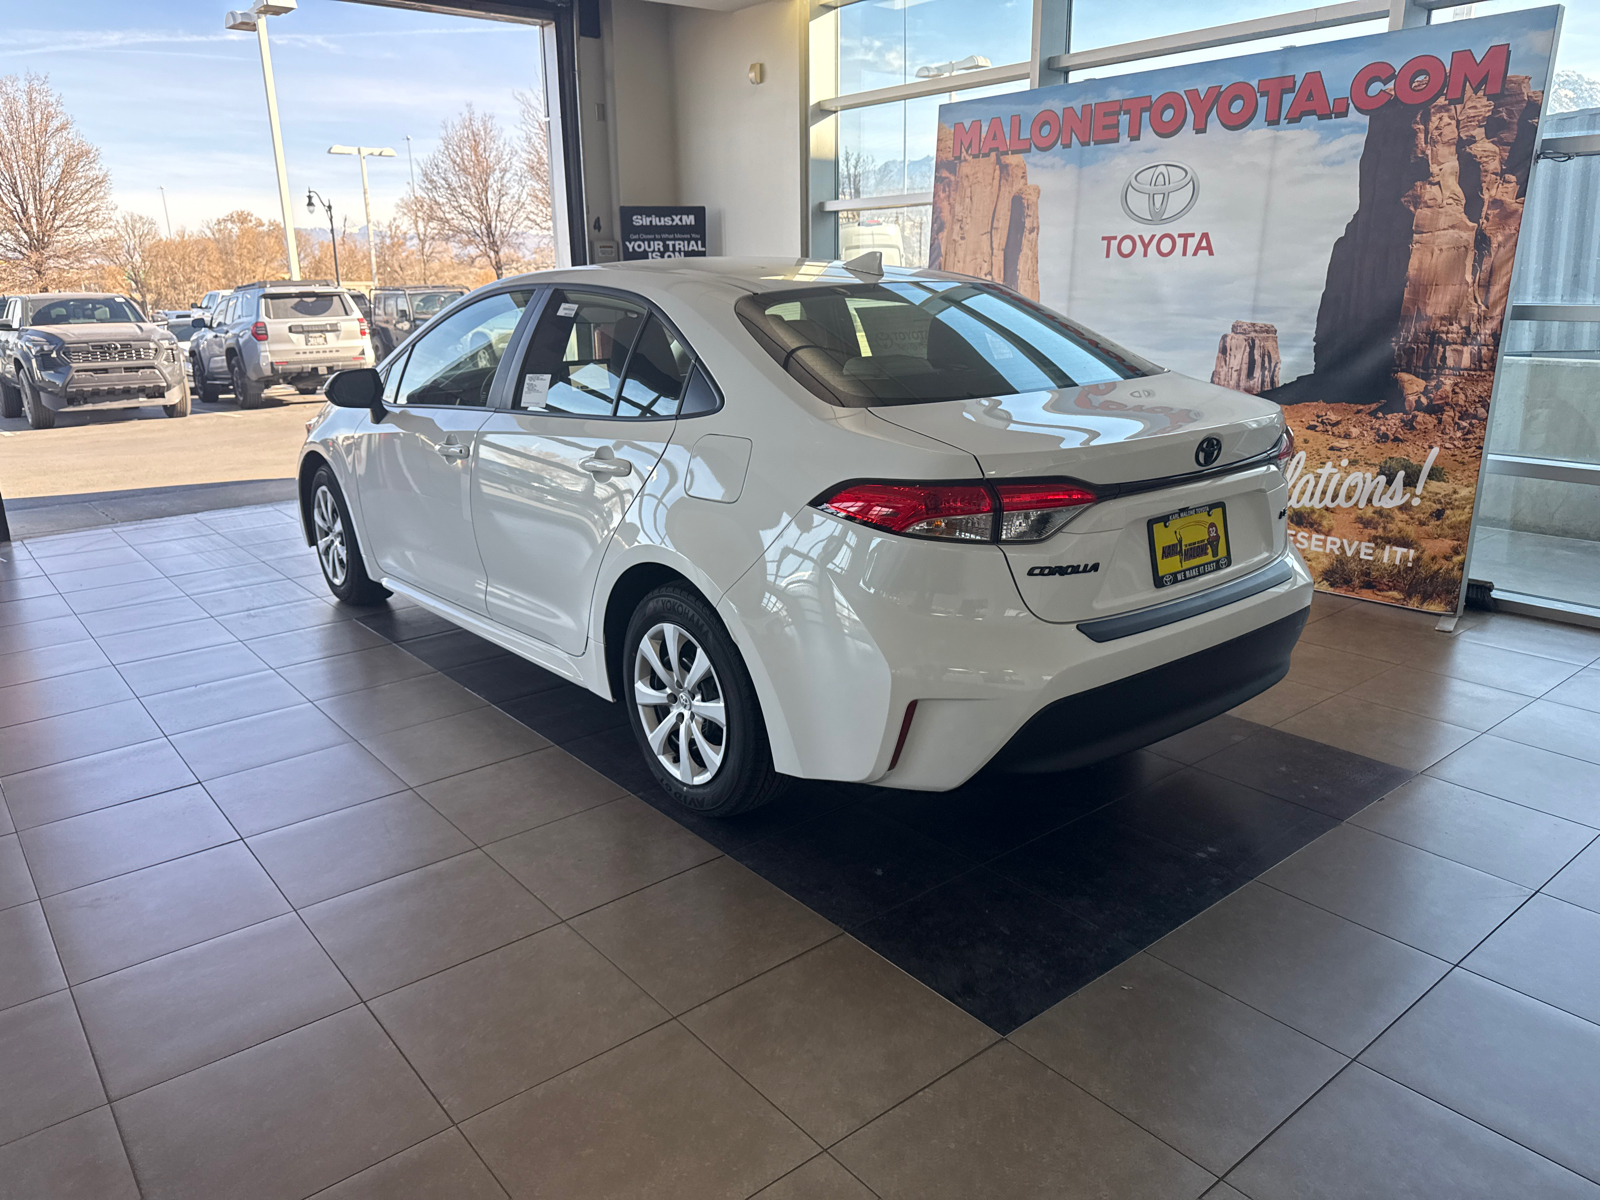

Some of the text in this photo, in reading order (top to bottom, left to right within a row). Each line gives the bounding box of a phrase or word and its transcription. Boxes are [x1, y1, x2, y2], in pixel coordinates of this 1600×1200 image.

[952, 43, 1511, 159] MALONETOYOTA.COM
[632, 214, 695, 226] SiriusXM
[625, 240, 706, 252] YOUR TRIAL
[1101, 232, 1215, 259] TOYOTA
[1209, 527, 1217, 537] 32
[1383, 545, 1415, 567] IT!
[1027, 561, 1100, 576] COROLLA
[1177, 562, 1217, 581] WE MAKE IT EASY
[661, 599, 710, 636] YOKOHAMA
